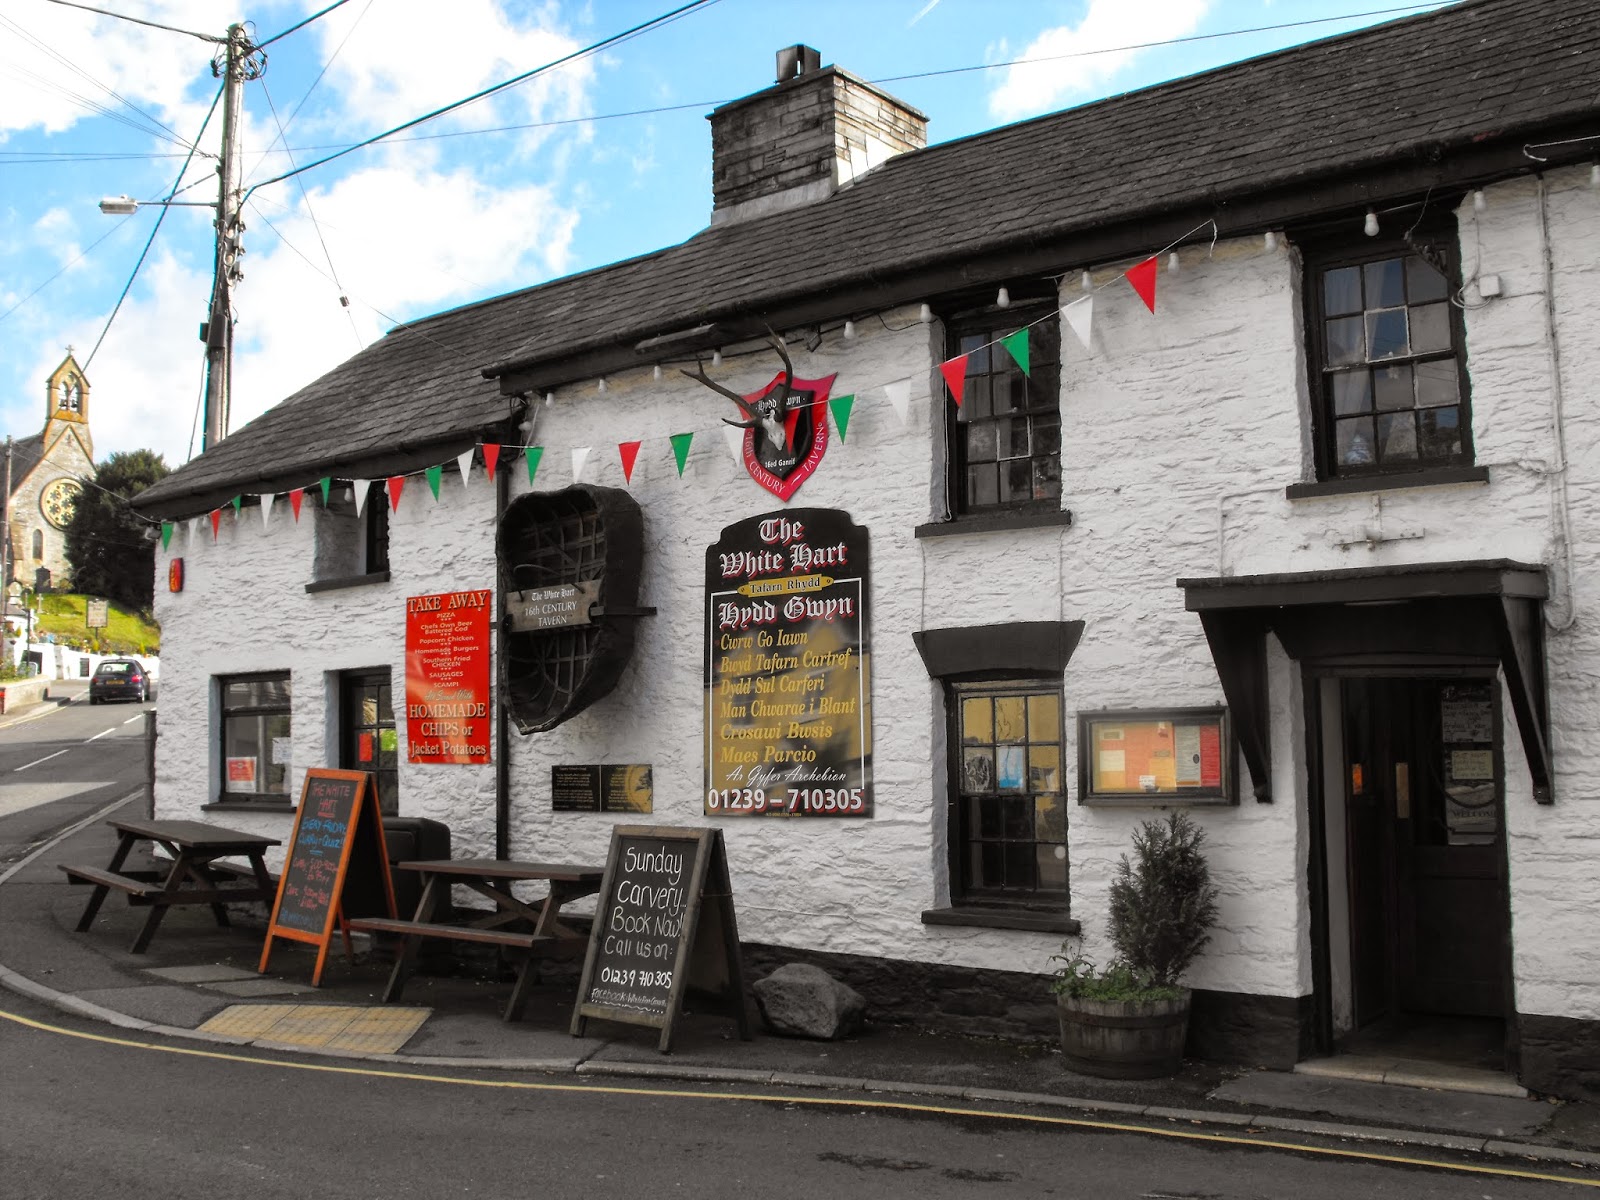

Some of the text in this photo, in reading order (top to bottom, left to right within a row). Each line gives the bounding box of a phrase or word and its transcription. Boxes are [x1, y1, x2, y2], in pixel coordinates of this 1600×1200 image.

[750, 461, 786, 493] CENTURY
[802, 427, 824, 472] TAVERN
[758, 518, 804, 546] The
[719, 542, 848, 577] White Hart
[532, 588, 575, 601] The White Hart
[750, 577, 820, 595] Tafarn Rhydd
[408, 592, 487, 613] TAKE AWAY
[525, 601, 577, 616] 16th CENTURY
[718, 596, 854, 630] Hydd Gwyn
[538, 615, 567, 627] TAVERN
[720, 629, 808, 650] Cwrw Go Iawn
[720, 648, 851, 675] Bwyd Tafarn Cartref
[720, 674, 825, 698] Dydd Sul Carferi
[409, 703, 486, 718] HOMEMADE
[720, 702, 746, 718] Man
[751, 699, 805, 717] Chwarae
[818, 697, 855, 715] Blant
[421, 722, 473, 736] CHIPS or
[720, 721, 833, 740] Crosawi Bwsis
[411, 741, 487, 757] Jacket Potatoes
[720, 745, 816, 763] Maes Parcio
[726, 765, 847, 788] Ar Gyfer Archebion
[326, 785, 351, 797] WHITE
[708, 788, 765, 809] 01239
[787, 788, 863, 810] 710305
[624, 846, 683, 885] Sunday
[611, 906, 651, 935] Book
[605, 935, 631, 957] Call
[636, 941, 651, 958] us
[601, 967, 636, 987] 01239
